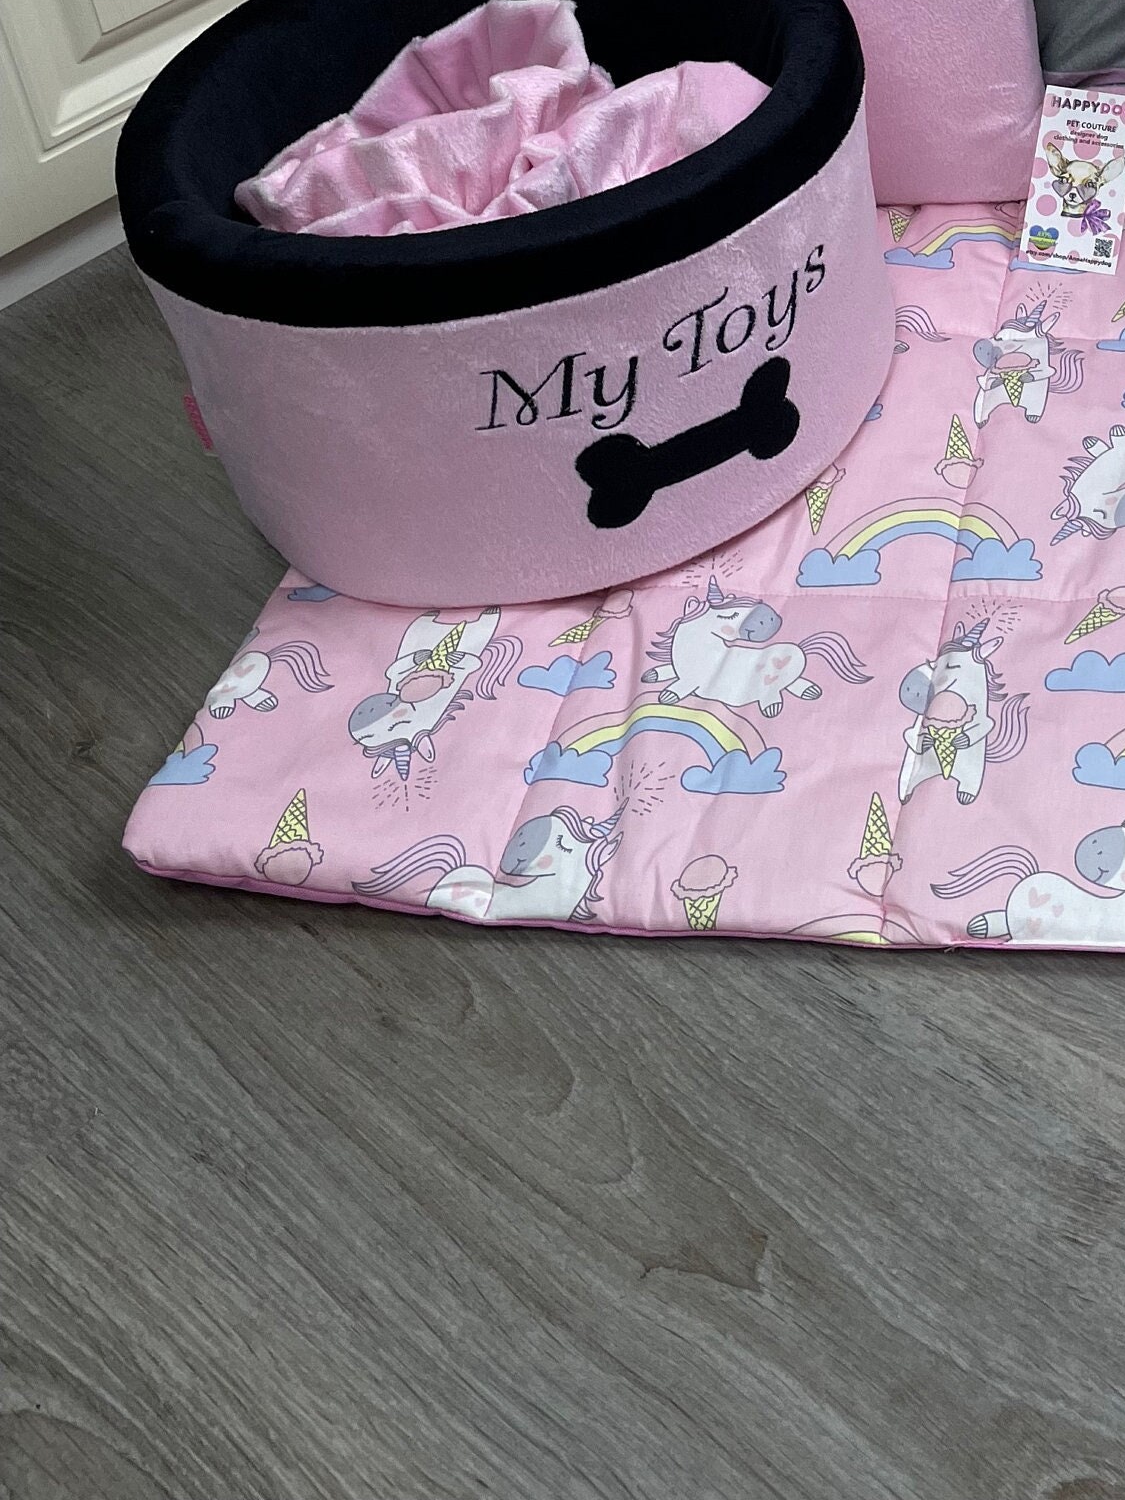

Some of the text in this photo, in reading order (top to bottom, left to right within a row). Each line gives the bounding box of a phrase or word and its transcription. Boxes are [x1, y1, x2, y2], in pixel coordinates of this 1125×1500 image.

[1066, 119, 1117, 133] PET COUTURE
[1053, 134, 1078, 145] clothing
[1091, 140, 1124, 150] accessories
[1070, 129, 1108, 141] designer dog
[475, 244, 825, 430] My Toys
